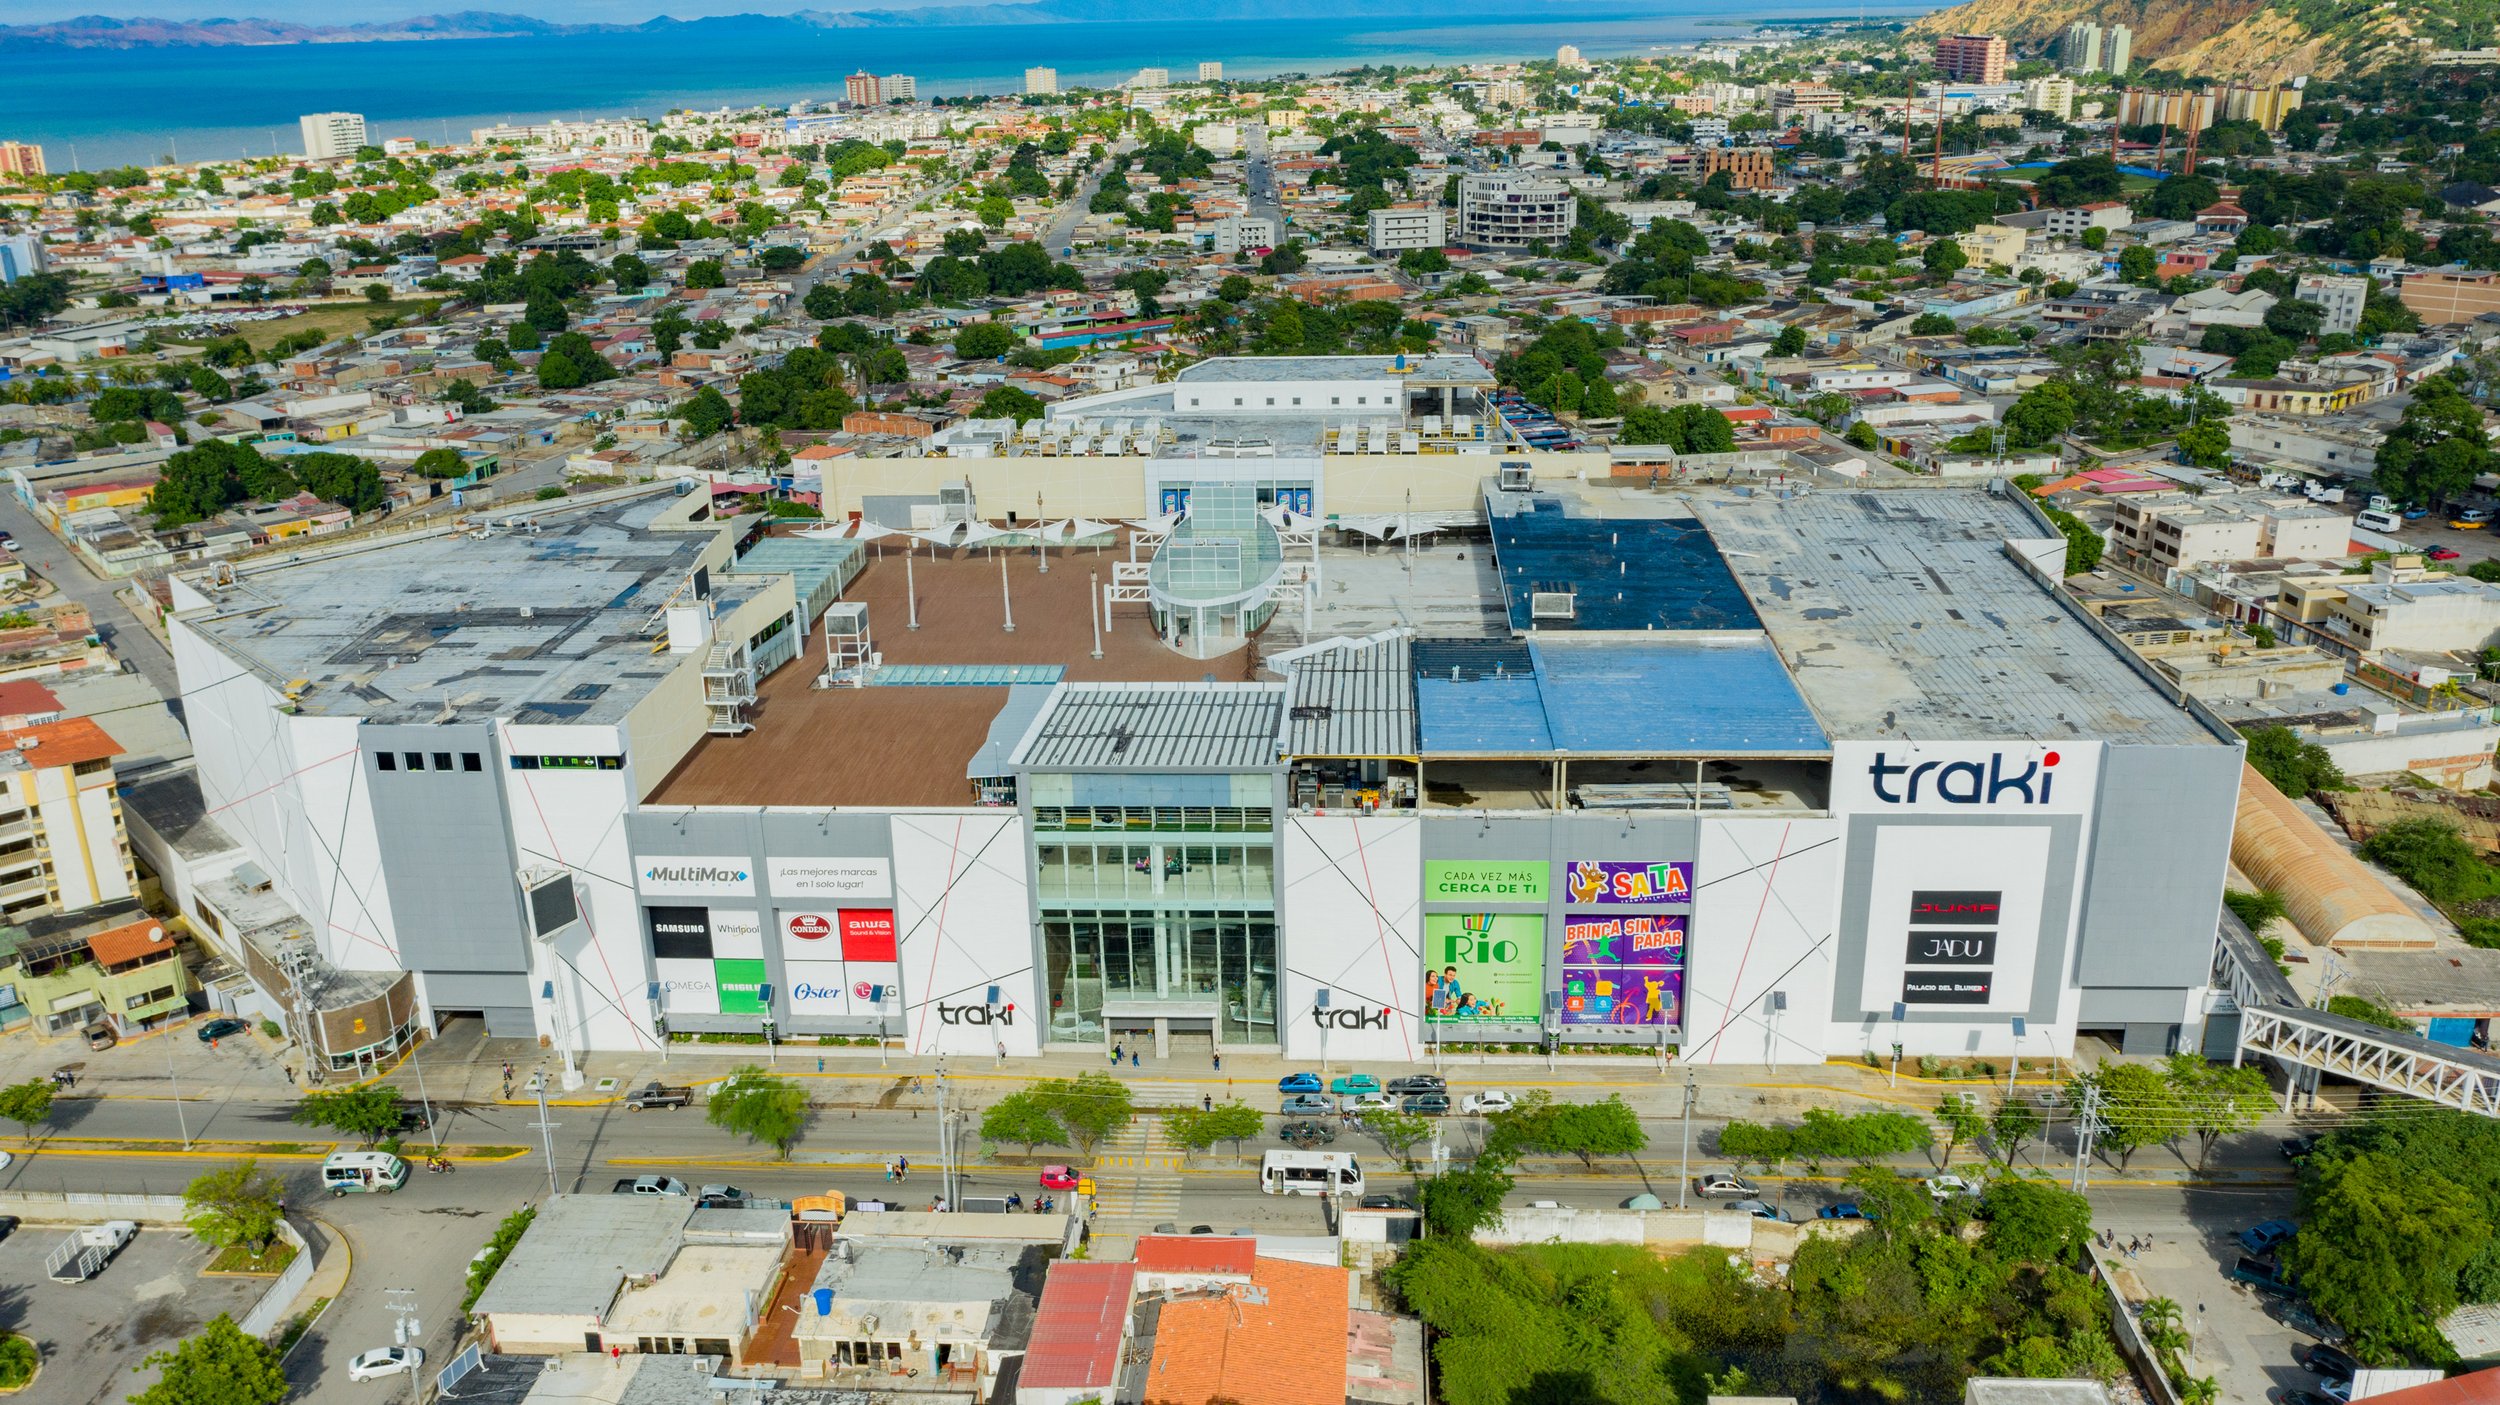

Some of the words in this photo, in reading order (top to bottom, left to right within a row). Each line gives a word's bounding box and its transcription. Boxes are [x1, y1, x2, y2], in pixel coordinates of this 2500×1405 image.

[1868, 751, 2060, 804] traki
[651, 866, 741, 882] MultiMax
[780, 868, 797, 876] ¡Las
[800, 868, 838, 877] mejores
[1444, 872, 1475, 881] CADA
[1482, 872, 1502, 881] VEZ
[1508, 870, 1532, 881] MÁS
[816, 880, 834, 888] solo
[837, 880, 863, 890] lugar!
[1614, 863, 1687, 900] SALTA
[1439, 883, 1490, 893] CERCA
[1497, 884, 1516, 893] DE
[1524, 884, 1537, 893] TI
[1914, 904, 1999, 913] JUMP
[656, 924, 704, 933] SAMSUNG
[718, 923, 760, 935] Whirlpool
[791, 925, 829, 934] CONDESA
[849, 921, 890, 929] aiwa
[1566, 920, 1620, 941] BRINCA
[1625, 918, 1650, 934] SIN
[1634, 930, 1682, 950] PARAR
[1924, 939, 1982, 957] JADU
[722, 983, 760, 992] FRIGILU
[794, 983, 841, 1000] Oster
[938, 1002, 1014, 1025] traki
[1312, 1004, 1391, 1029] traki
